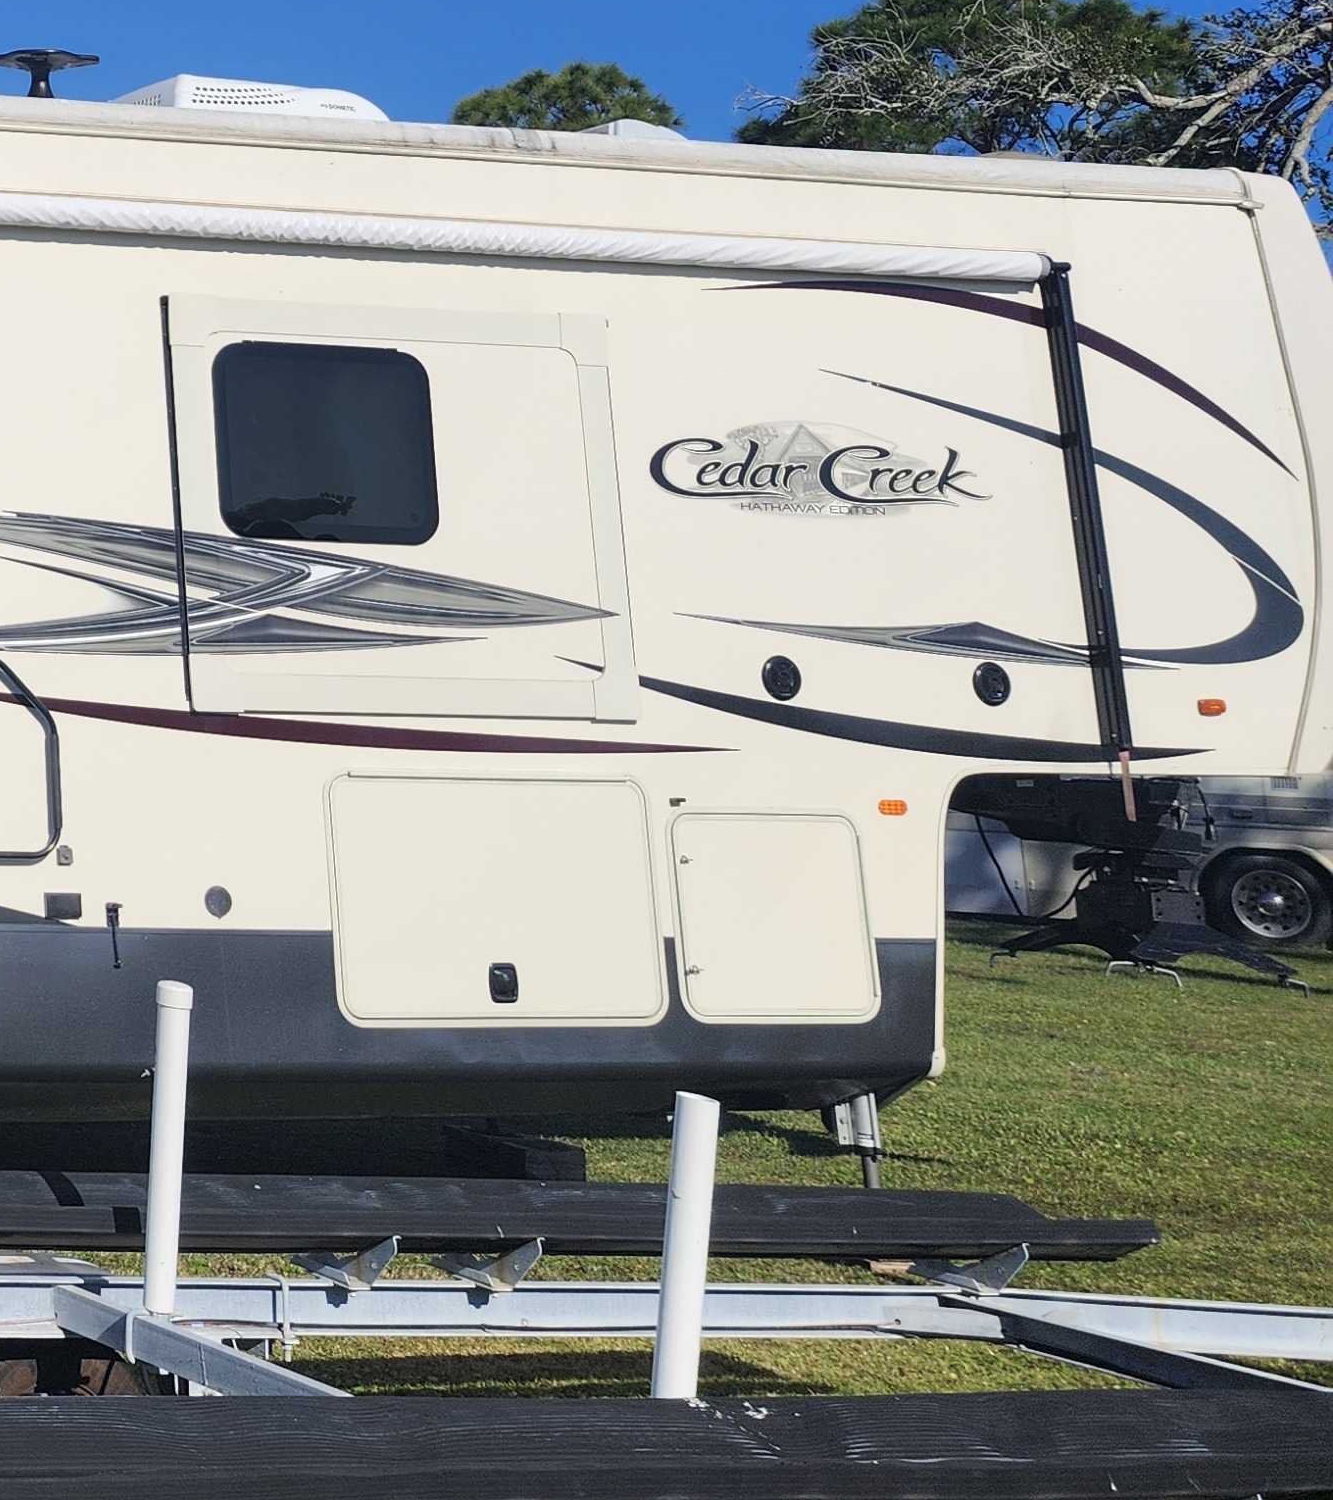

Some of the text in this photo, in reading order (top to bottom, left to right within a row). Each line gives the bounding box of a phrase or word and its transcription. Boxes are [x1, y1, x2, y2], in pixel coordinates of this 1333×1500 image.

[649, 437, 994, 507] Cedar Creek
[740, 502, 886, 516] HATHAWAY EDITION
